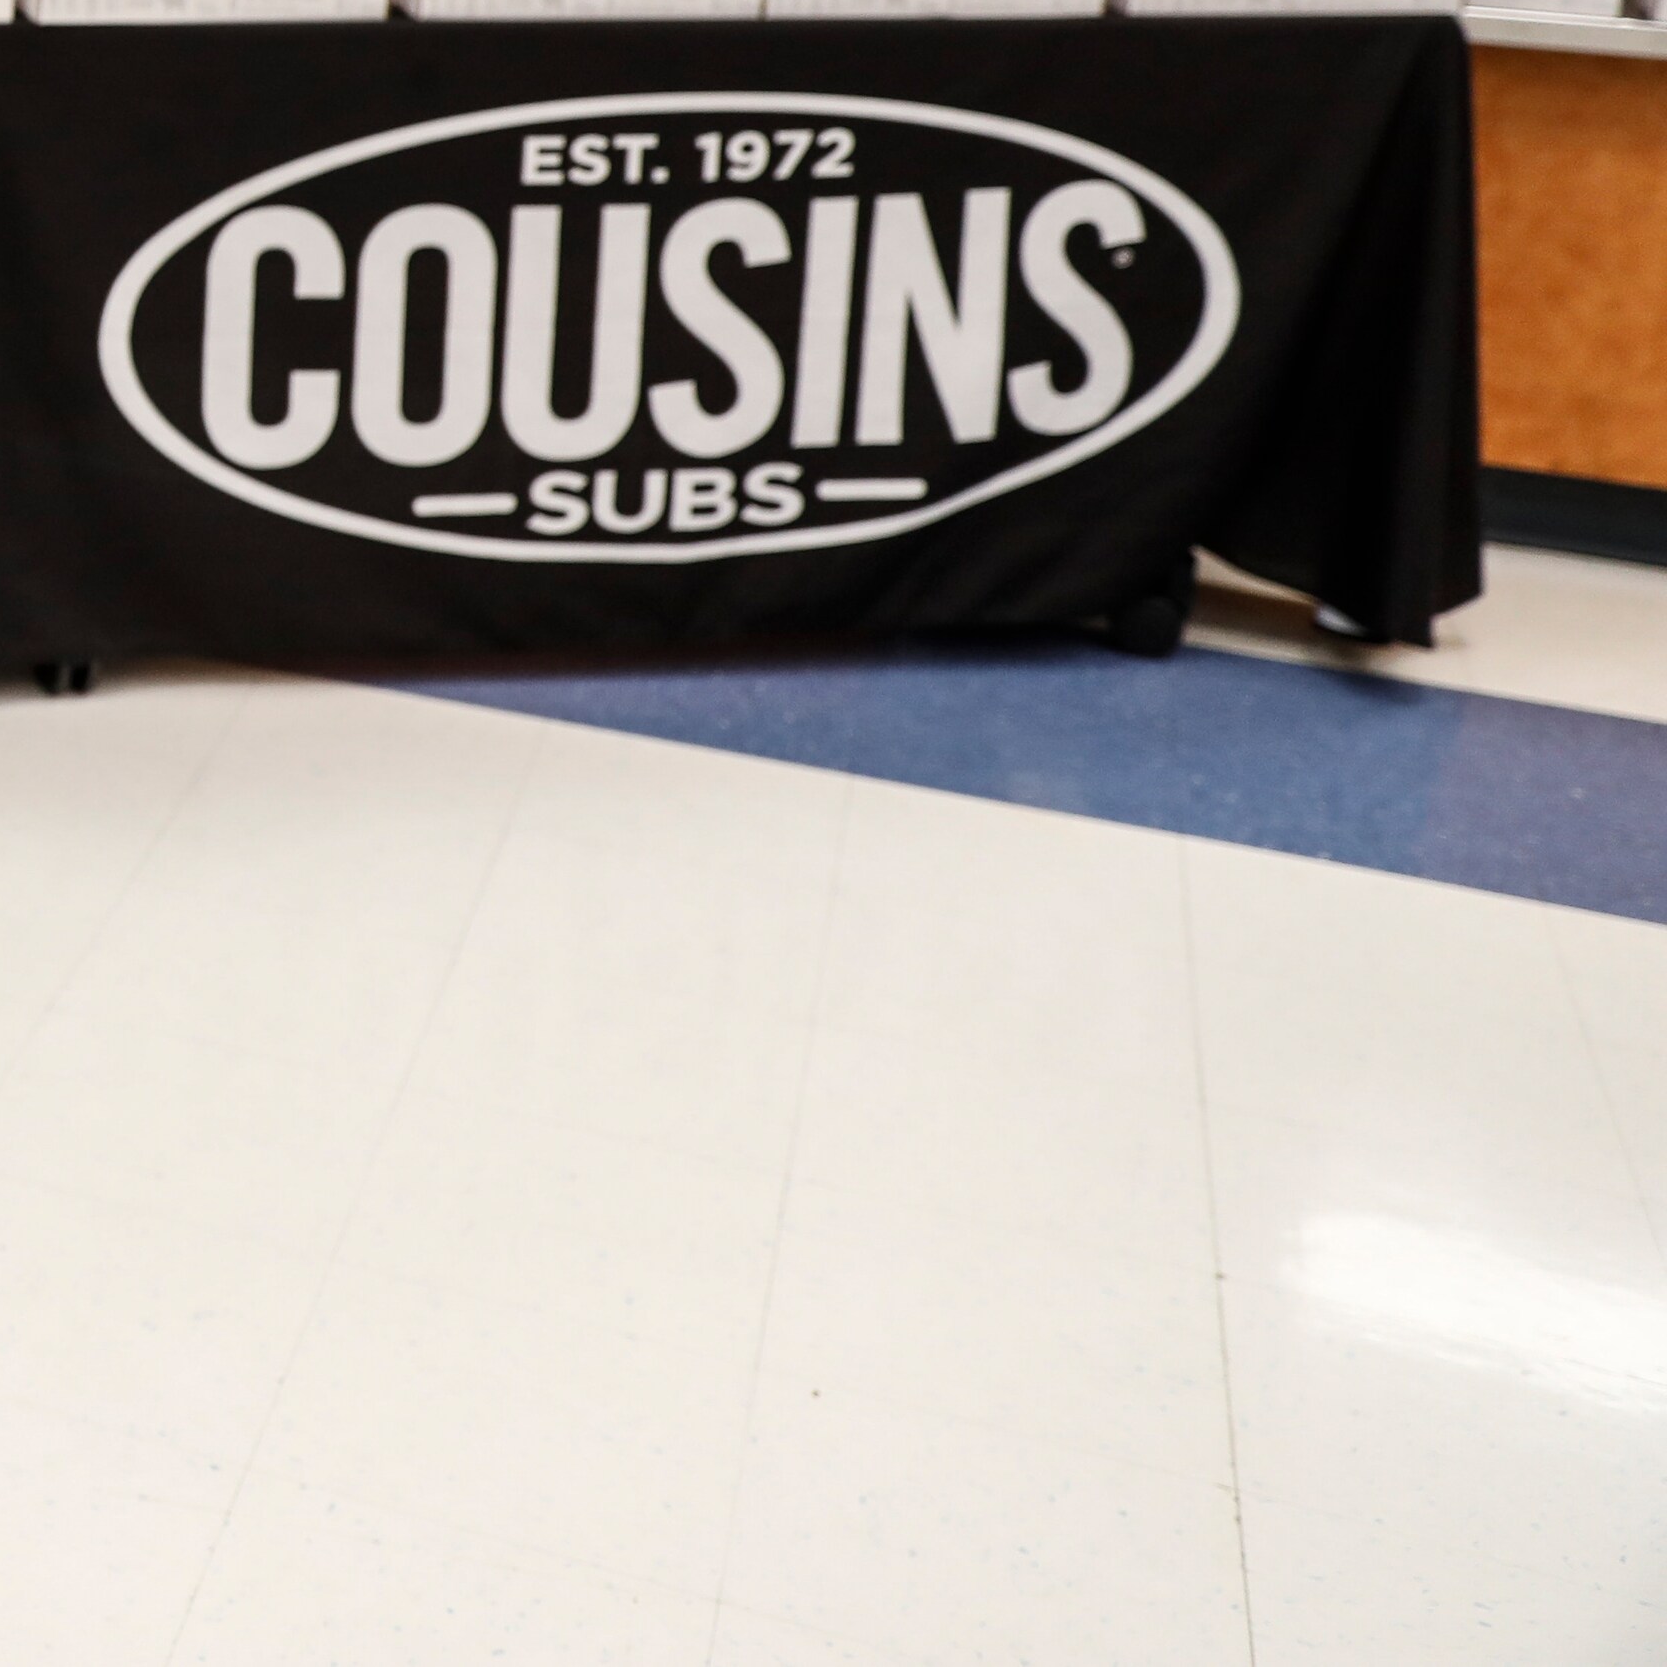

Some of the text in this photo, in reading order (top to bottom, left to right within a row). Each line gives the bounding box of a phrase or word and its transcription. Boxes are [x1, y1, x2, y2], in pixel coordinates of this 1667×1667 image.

[521, 127, 856, 186] EST. 1972
[201, 179, 1146, 469] COUSINS
[526, 461, 805, 535] SUBS
